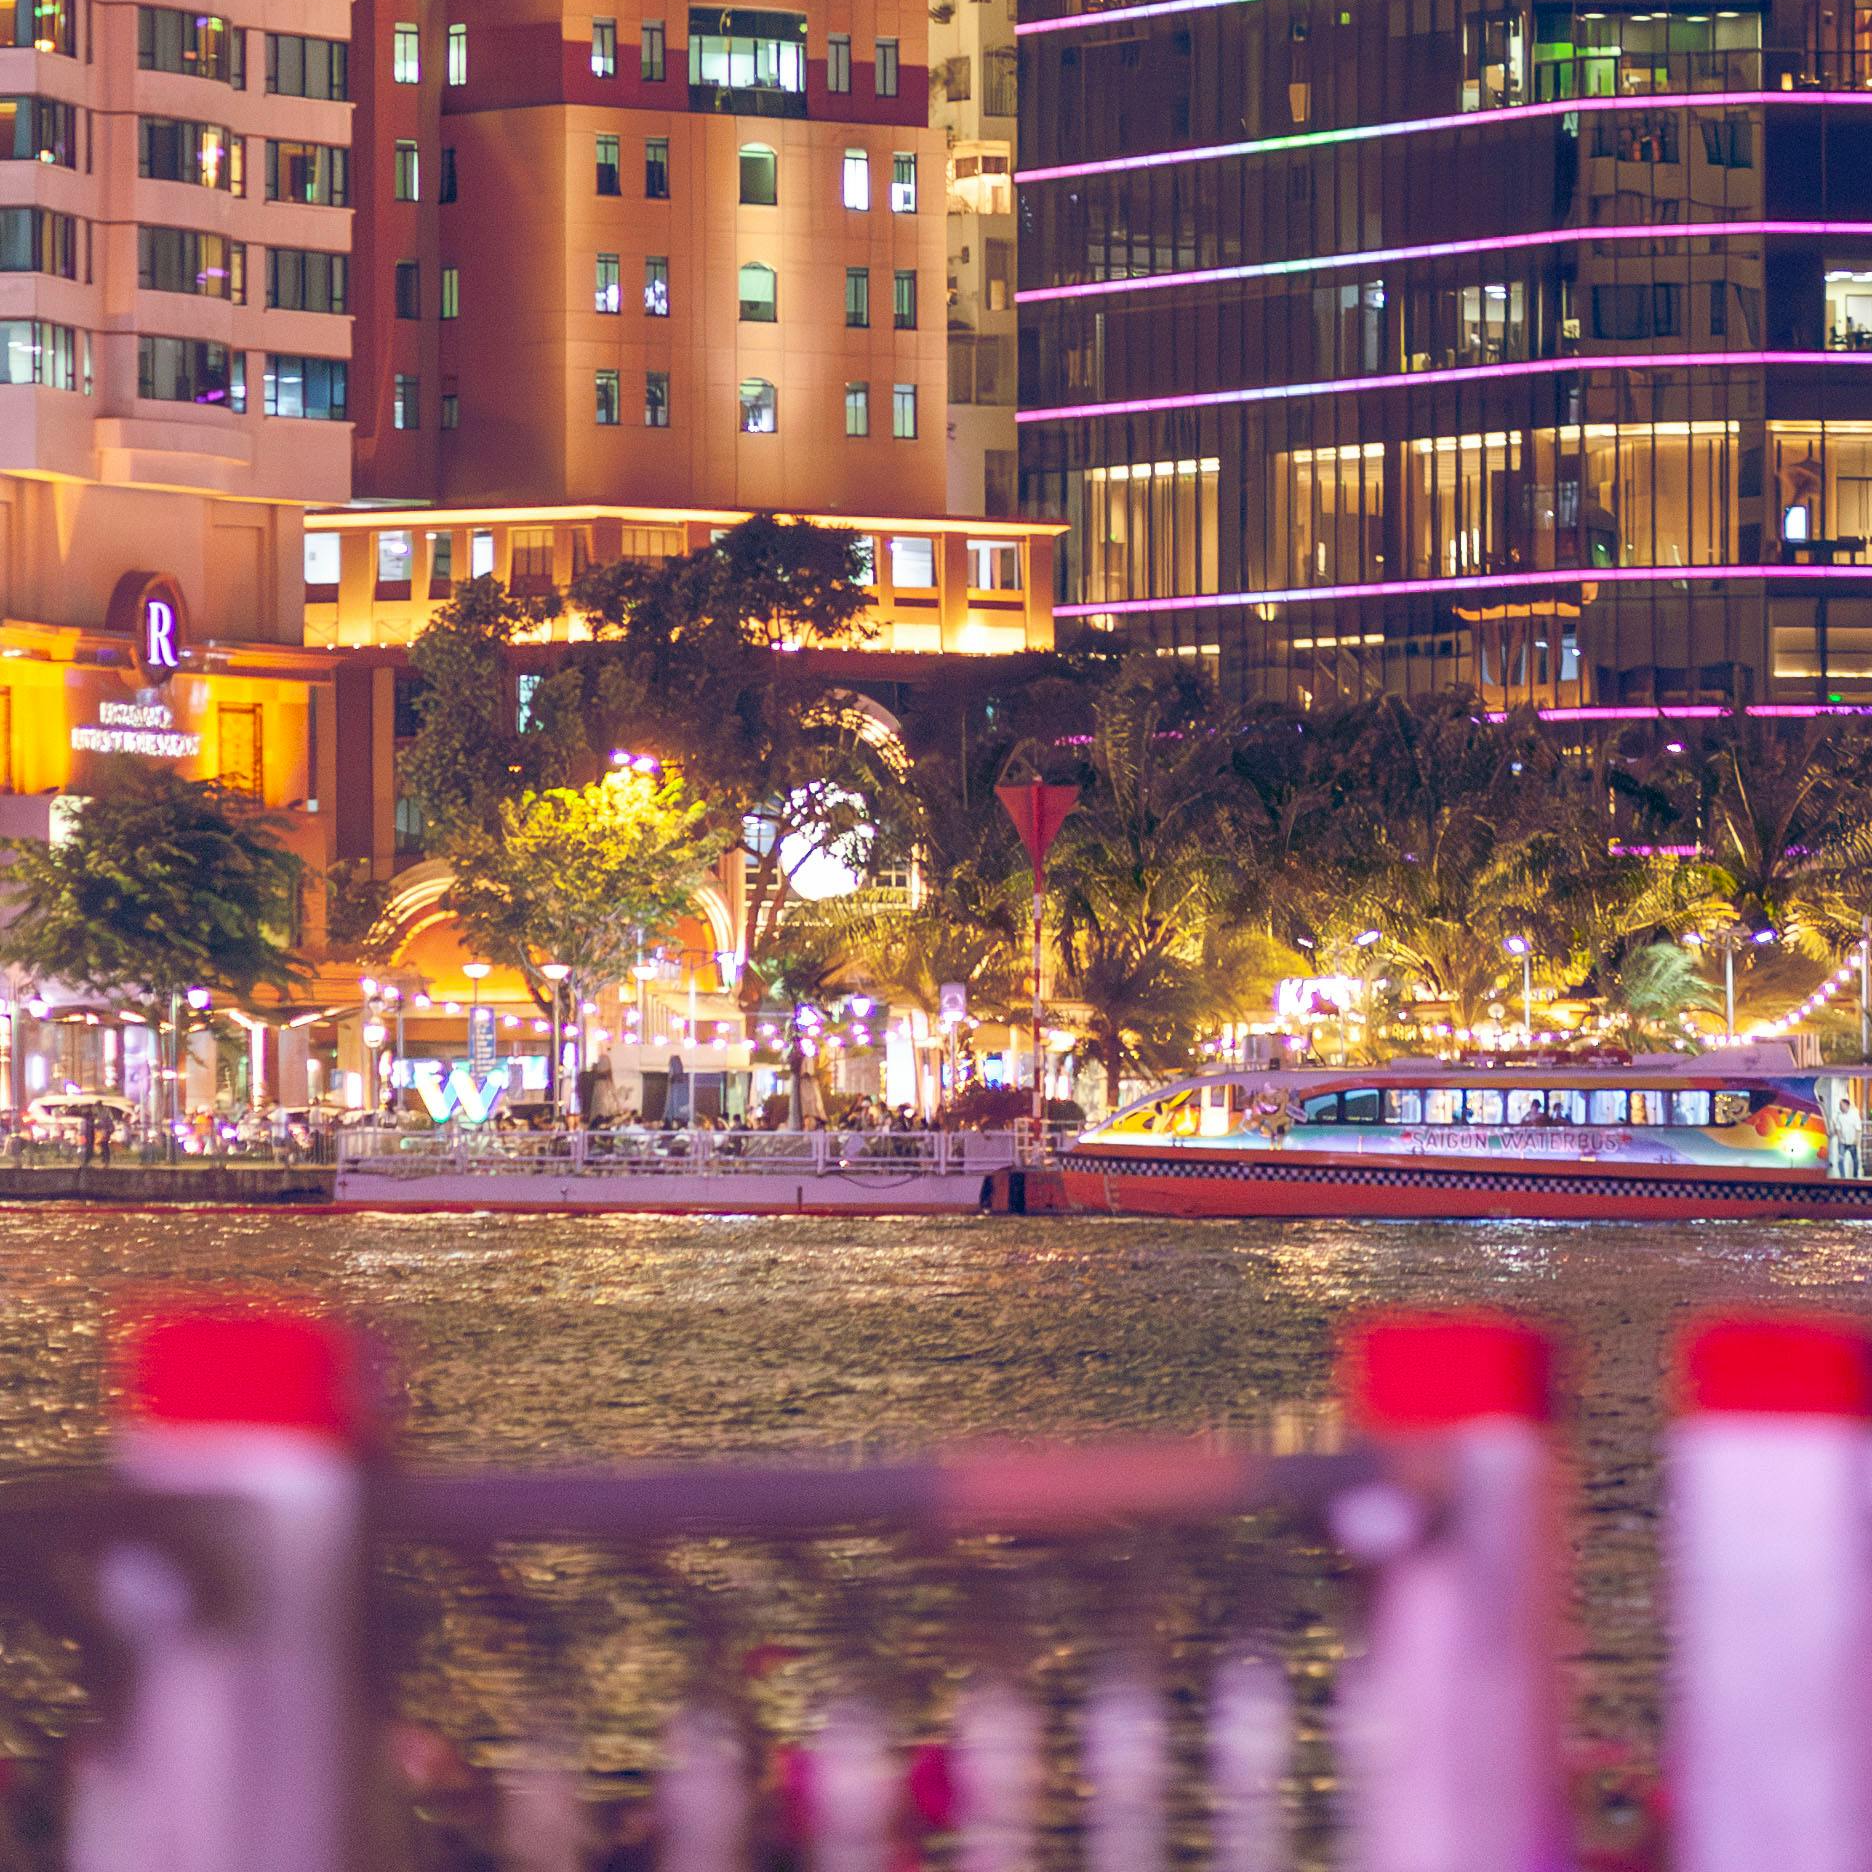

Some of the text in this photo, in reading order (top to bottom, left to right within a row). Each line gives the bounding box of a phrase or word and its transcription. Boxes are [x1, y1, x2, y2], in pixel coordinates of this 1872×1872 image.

[147, 601, 180, 668] R
[1411, 1132, 1618, 1152] SAIGON WATERBUS
